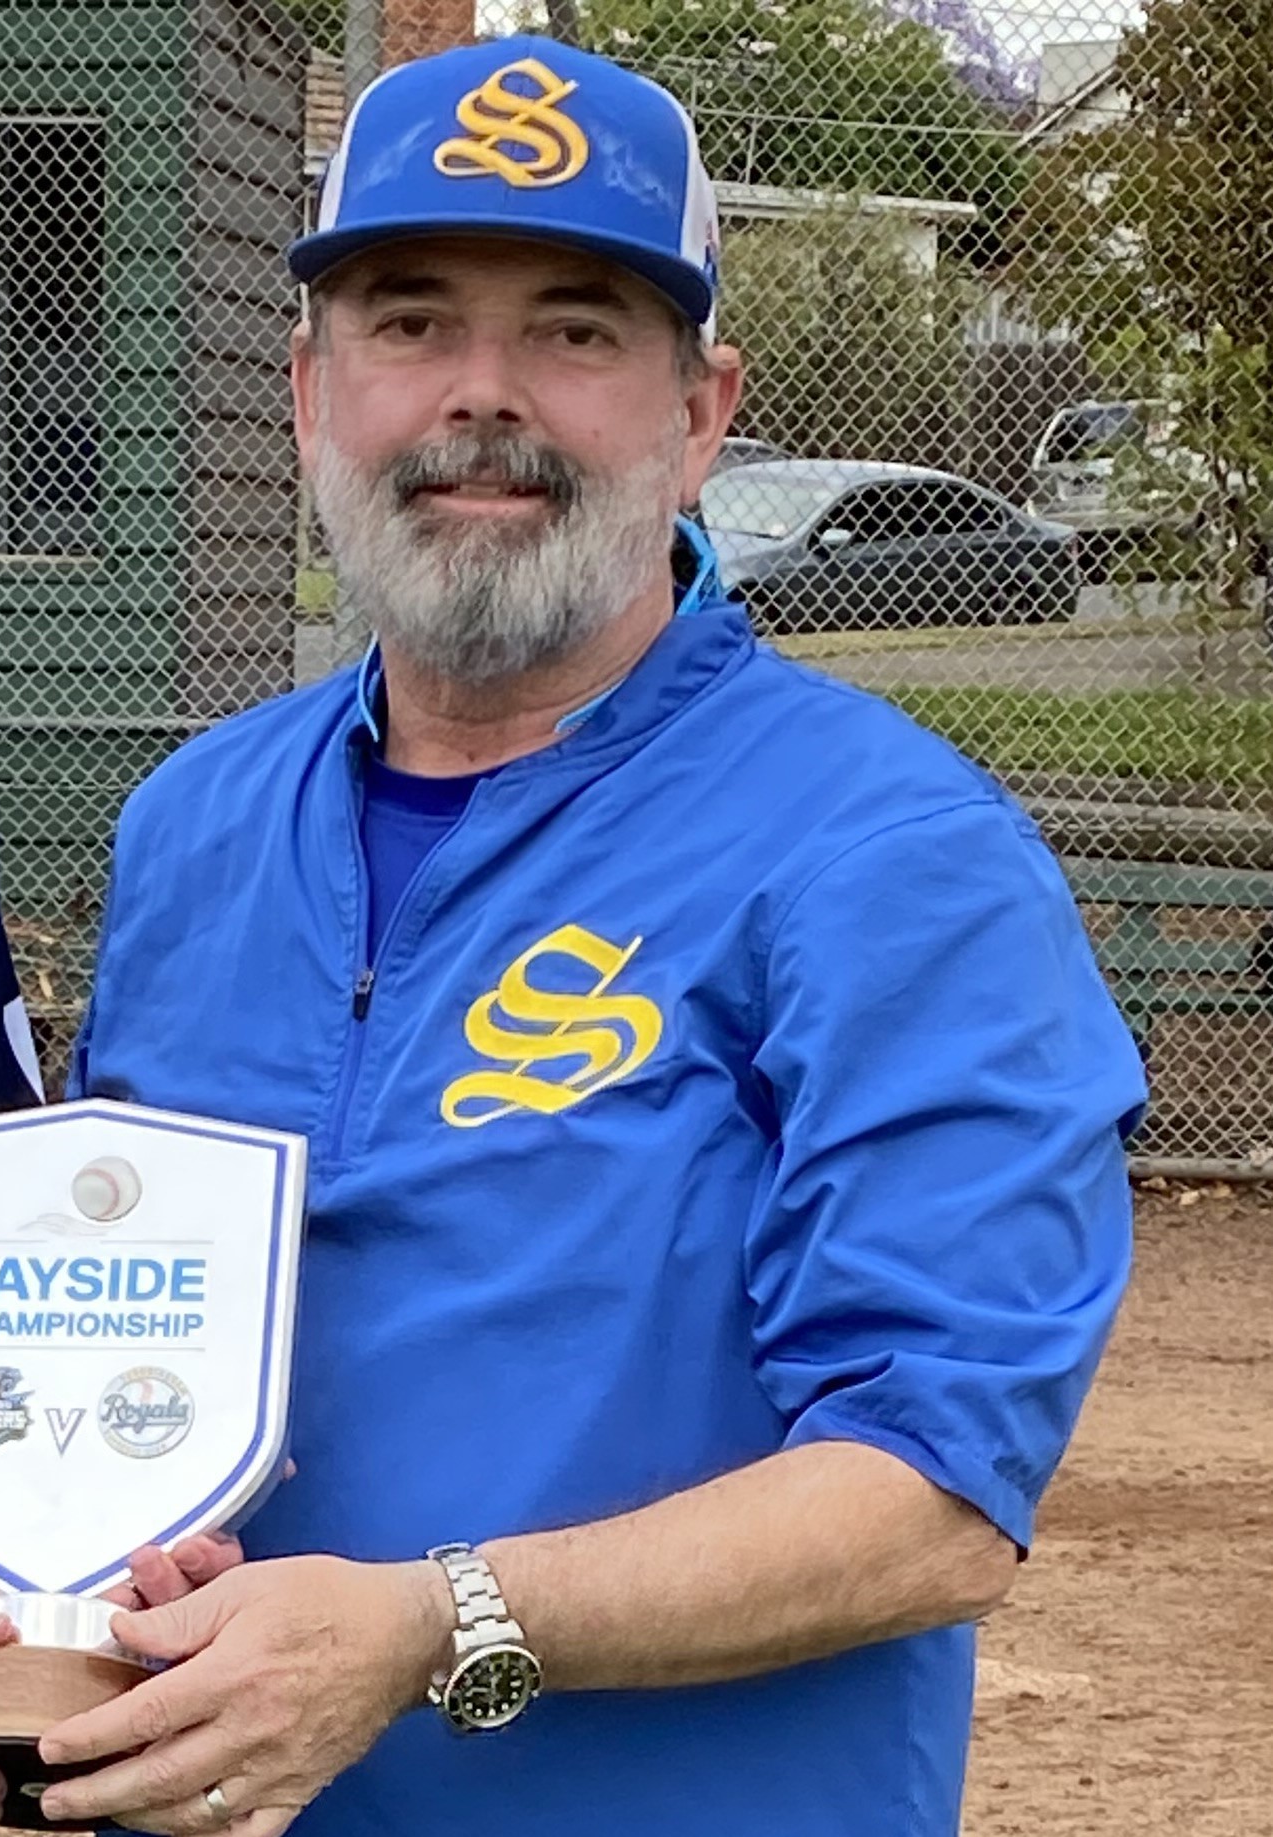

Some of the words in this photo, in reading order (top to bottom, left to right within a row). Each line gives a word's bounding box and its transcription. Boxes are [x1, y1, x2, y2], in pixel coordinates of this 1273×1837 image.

[433, 57, 589, 188] S
[440, 923, 663, 1128] S
[44, 1408, 87, 1457] V
